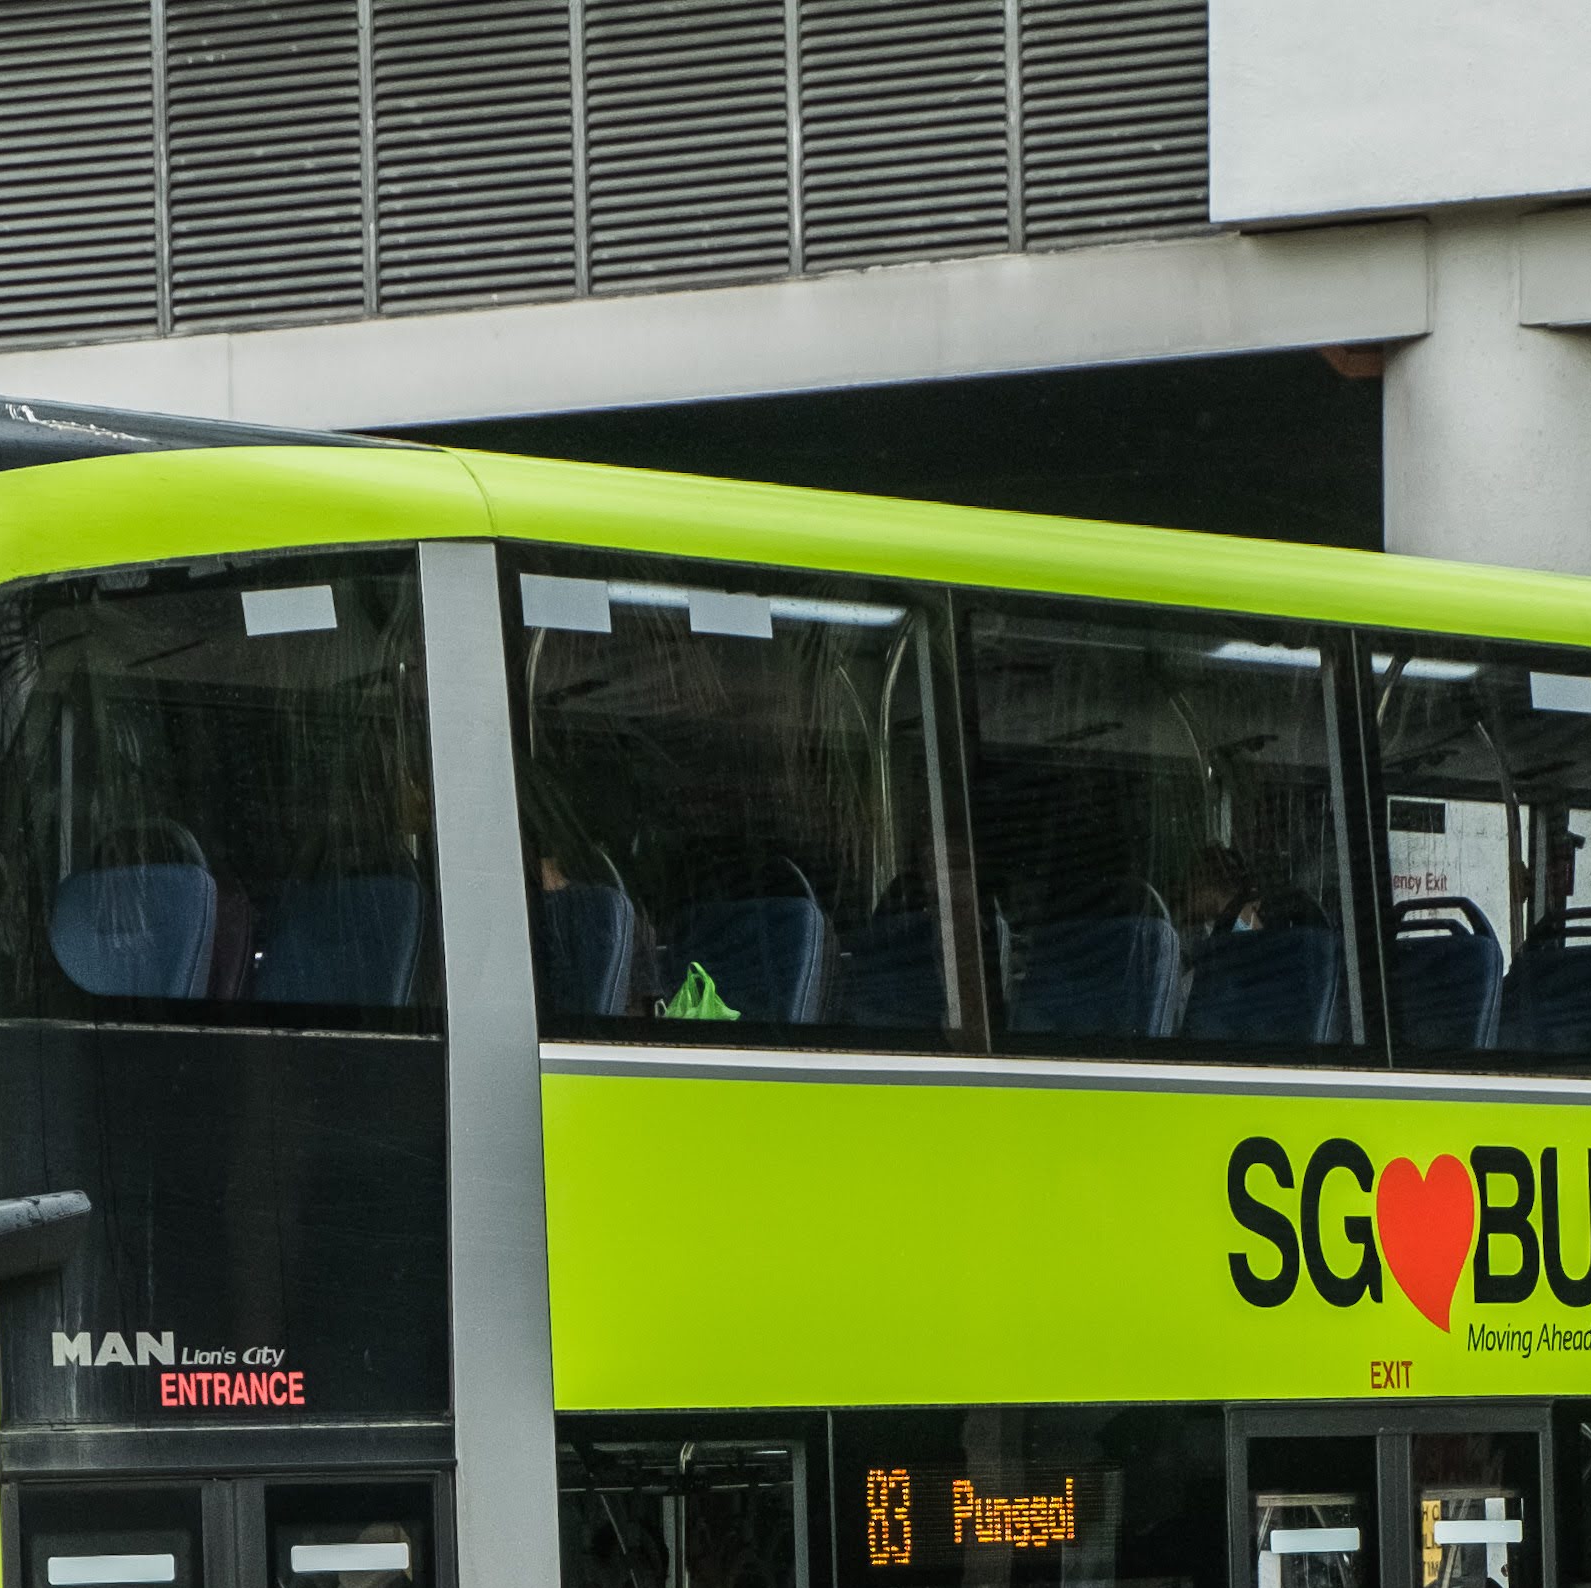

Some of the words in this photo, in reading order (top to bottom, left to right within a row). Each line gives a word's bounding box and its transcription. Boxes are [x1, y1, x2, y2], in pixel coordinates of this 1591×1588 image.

[1425, 872, 1448, 891] Exit
[51, 1331, 175, 1367] MAN
[180, 1346, 237, 1366] Lion's
[241, 1345, 285, 1368] City
[1467, 1322, 1533, 1359] Moving
[160, 1371, 305, 1407] ENTRANCE
[1370, 1360, 1412, 1389] EXIT
[866, 1468, 912, 1566] 83
[952, 1477, 1075, 1548] Punggol
